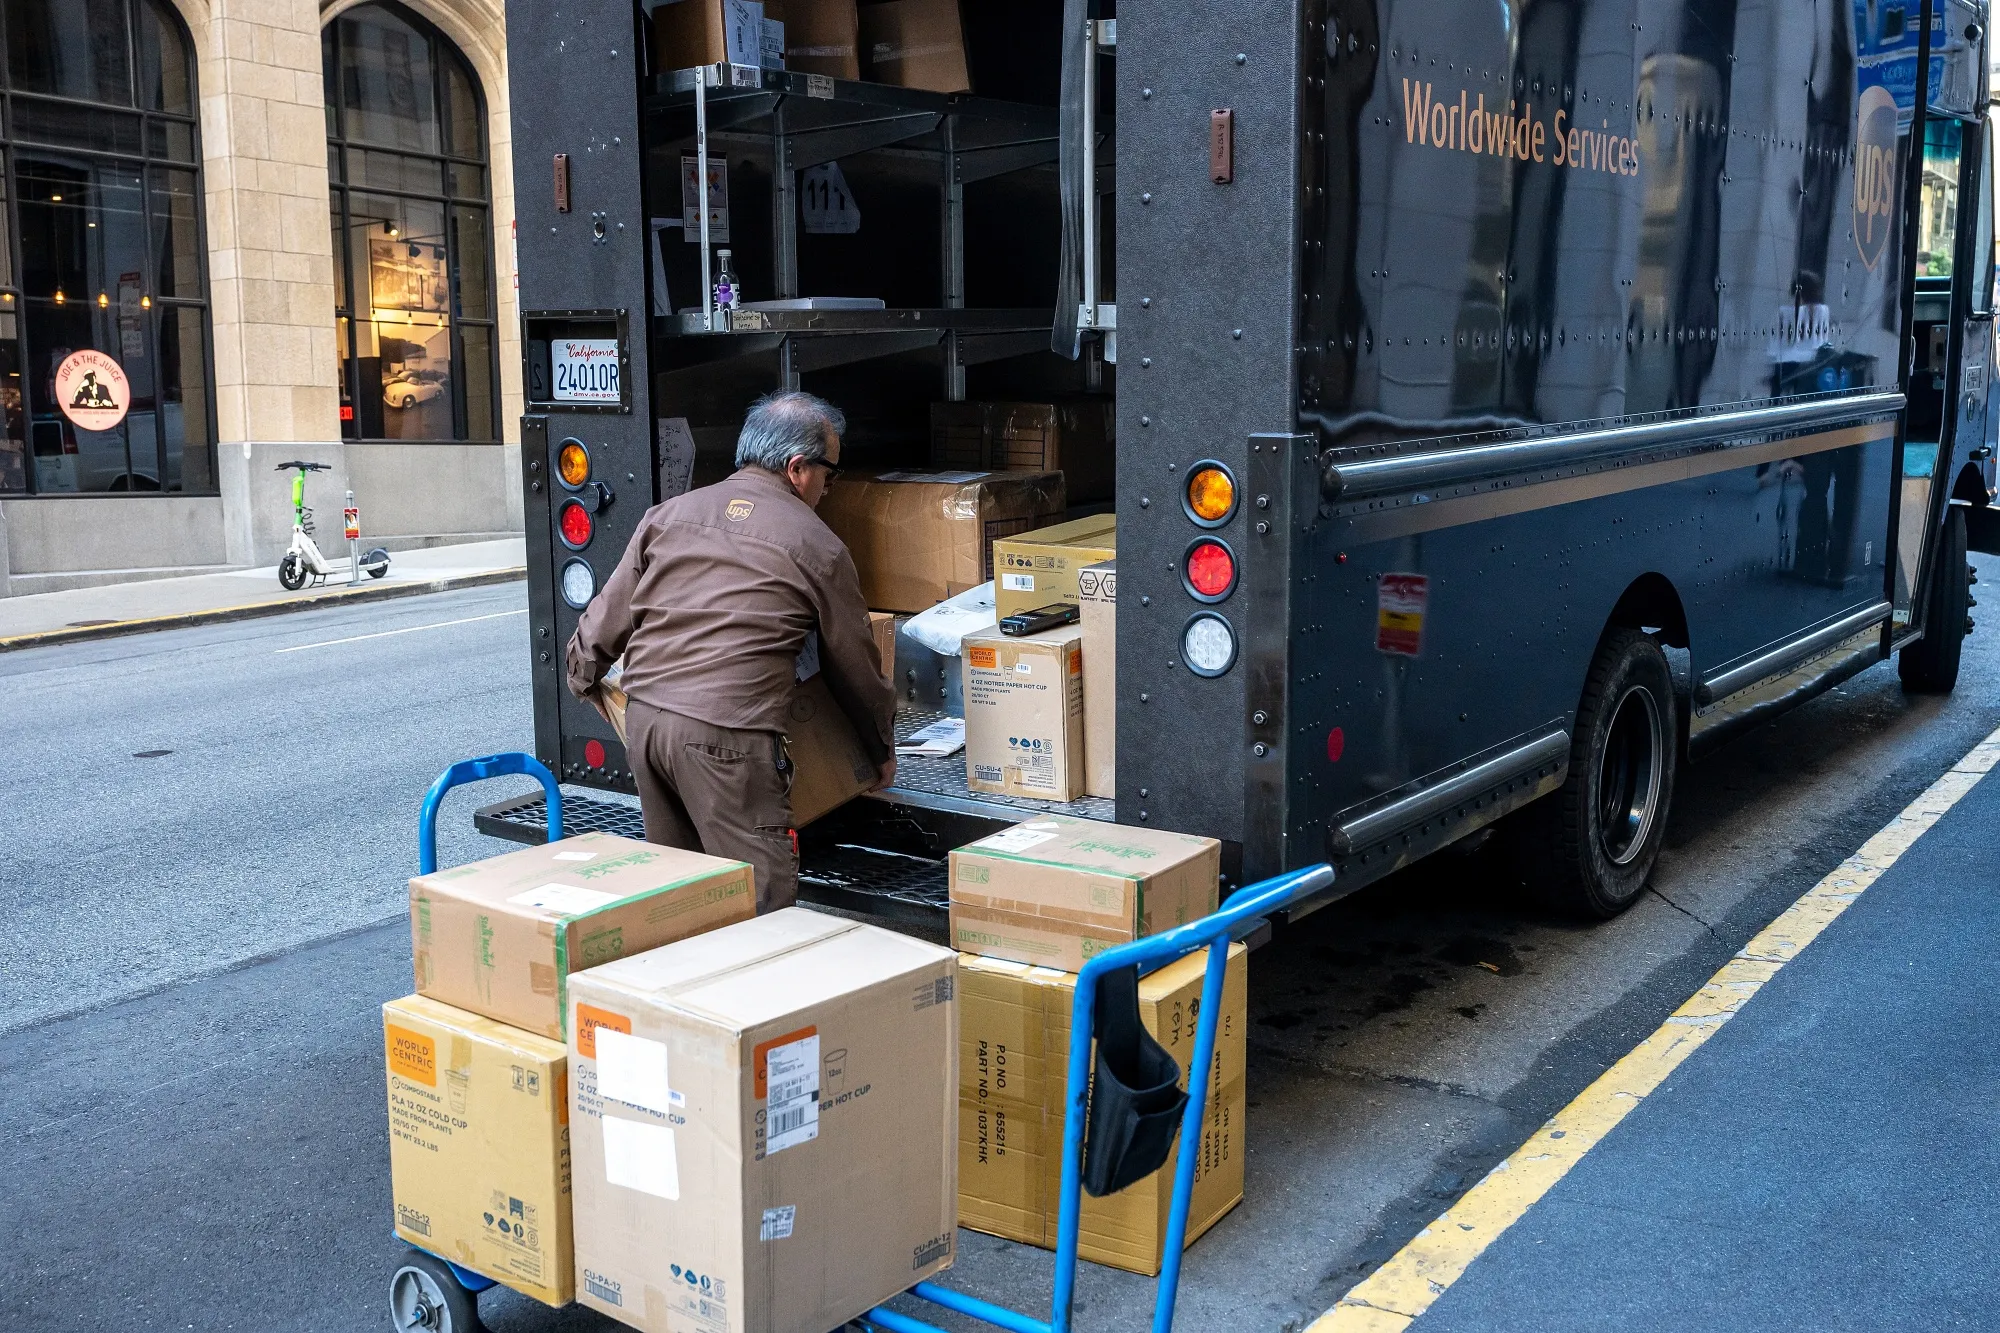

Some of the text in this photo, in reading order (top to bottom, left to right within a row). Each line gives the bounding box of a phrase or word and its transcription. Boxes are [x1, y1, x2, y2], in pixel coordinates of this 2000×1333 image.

[1402, 77, 1639, 177] Worldwide Services
[1857, 142, 1893, 244] ups
[568, 344, 619, 362] California
[60, 355, 122, 383] JOE & THE JUICE
[558, 363, 619, 392] 24010R
[727, 505, 750, 518] ups
[975, 764, 1002, 772] CU-SU-4
[396, 1037, 429, 1055] WORLD
[979, 1040, 988, 1075] PART
[393, 1048, 433, 1069] CENTRIC
[392, 1094, 468, 1129] PLA 12 OZ COLD CUP
[578, 1081, 585, 1092] 12
[587, 1084, 598, 1096] OZ
[668, 1113, 686, 1125] CUP
[595, 1100, 604, 1108] CT
[755, 1084, 871, 1138] 12 PER HOT CUP
[392, 1106, 452, 1135] MADE FROM PLANTS
[393, 1117, 418, 1133] 20/50 CT
[1215, 1113, 1220, 1127] IN
[393, 1129, 401, 1137] GR
[403, 1132, 412, 1141] WT
[427, 1143, 439, 1152] LBS
[978, 1108, 988, 1165] 1037KHK
[996, 1111, 1006, 1156] 655215
[398, 1204, 430, 1224] CP-CS-12
[913, 1232, 951, 1256] CU-PA-12
[584, 1268, 622, 1292] CU-PA-12
